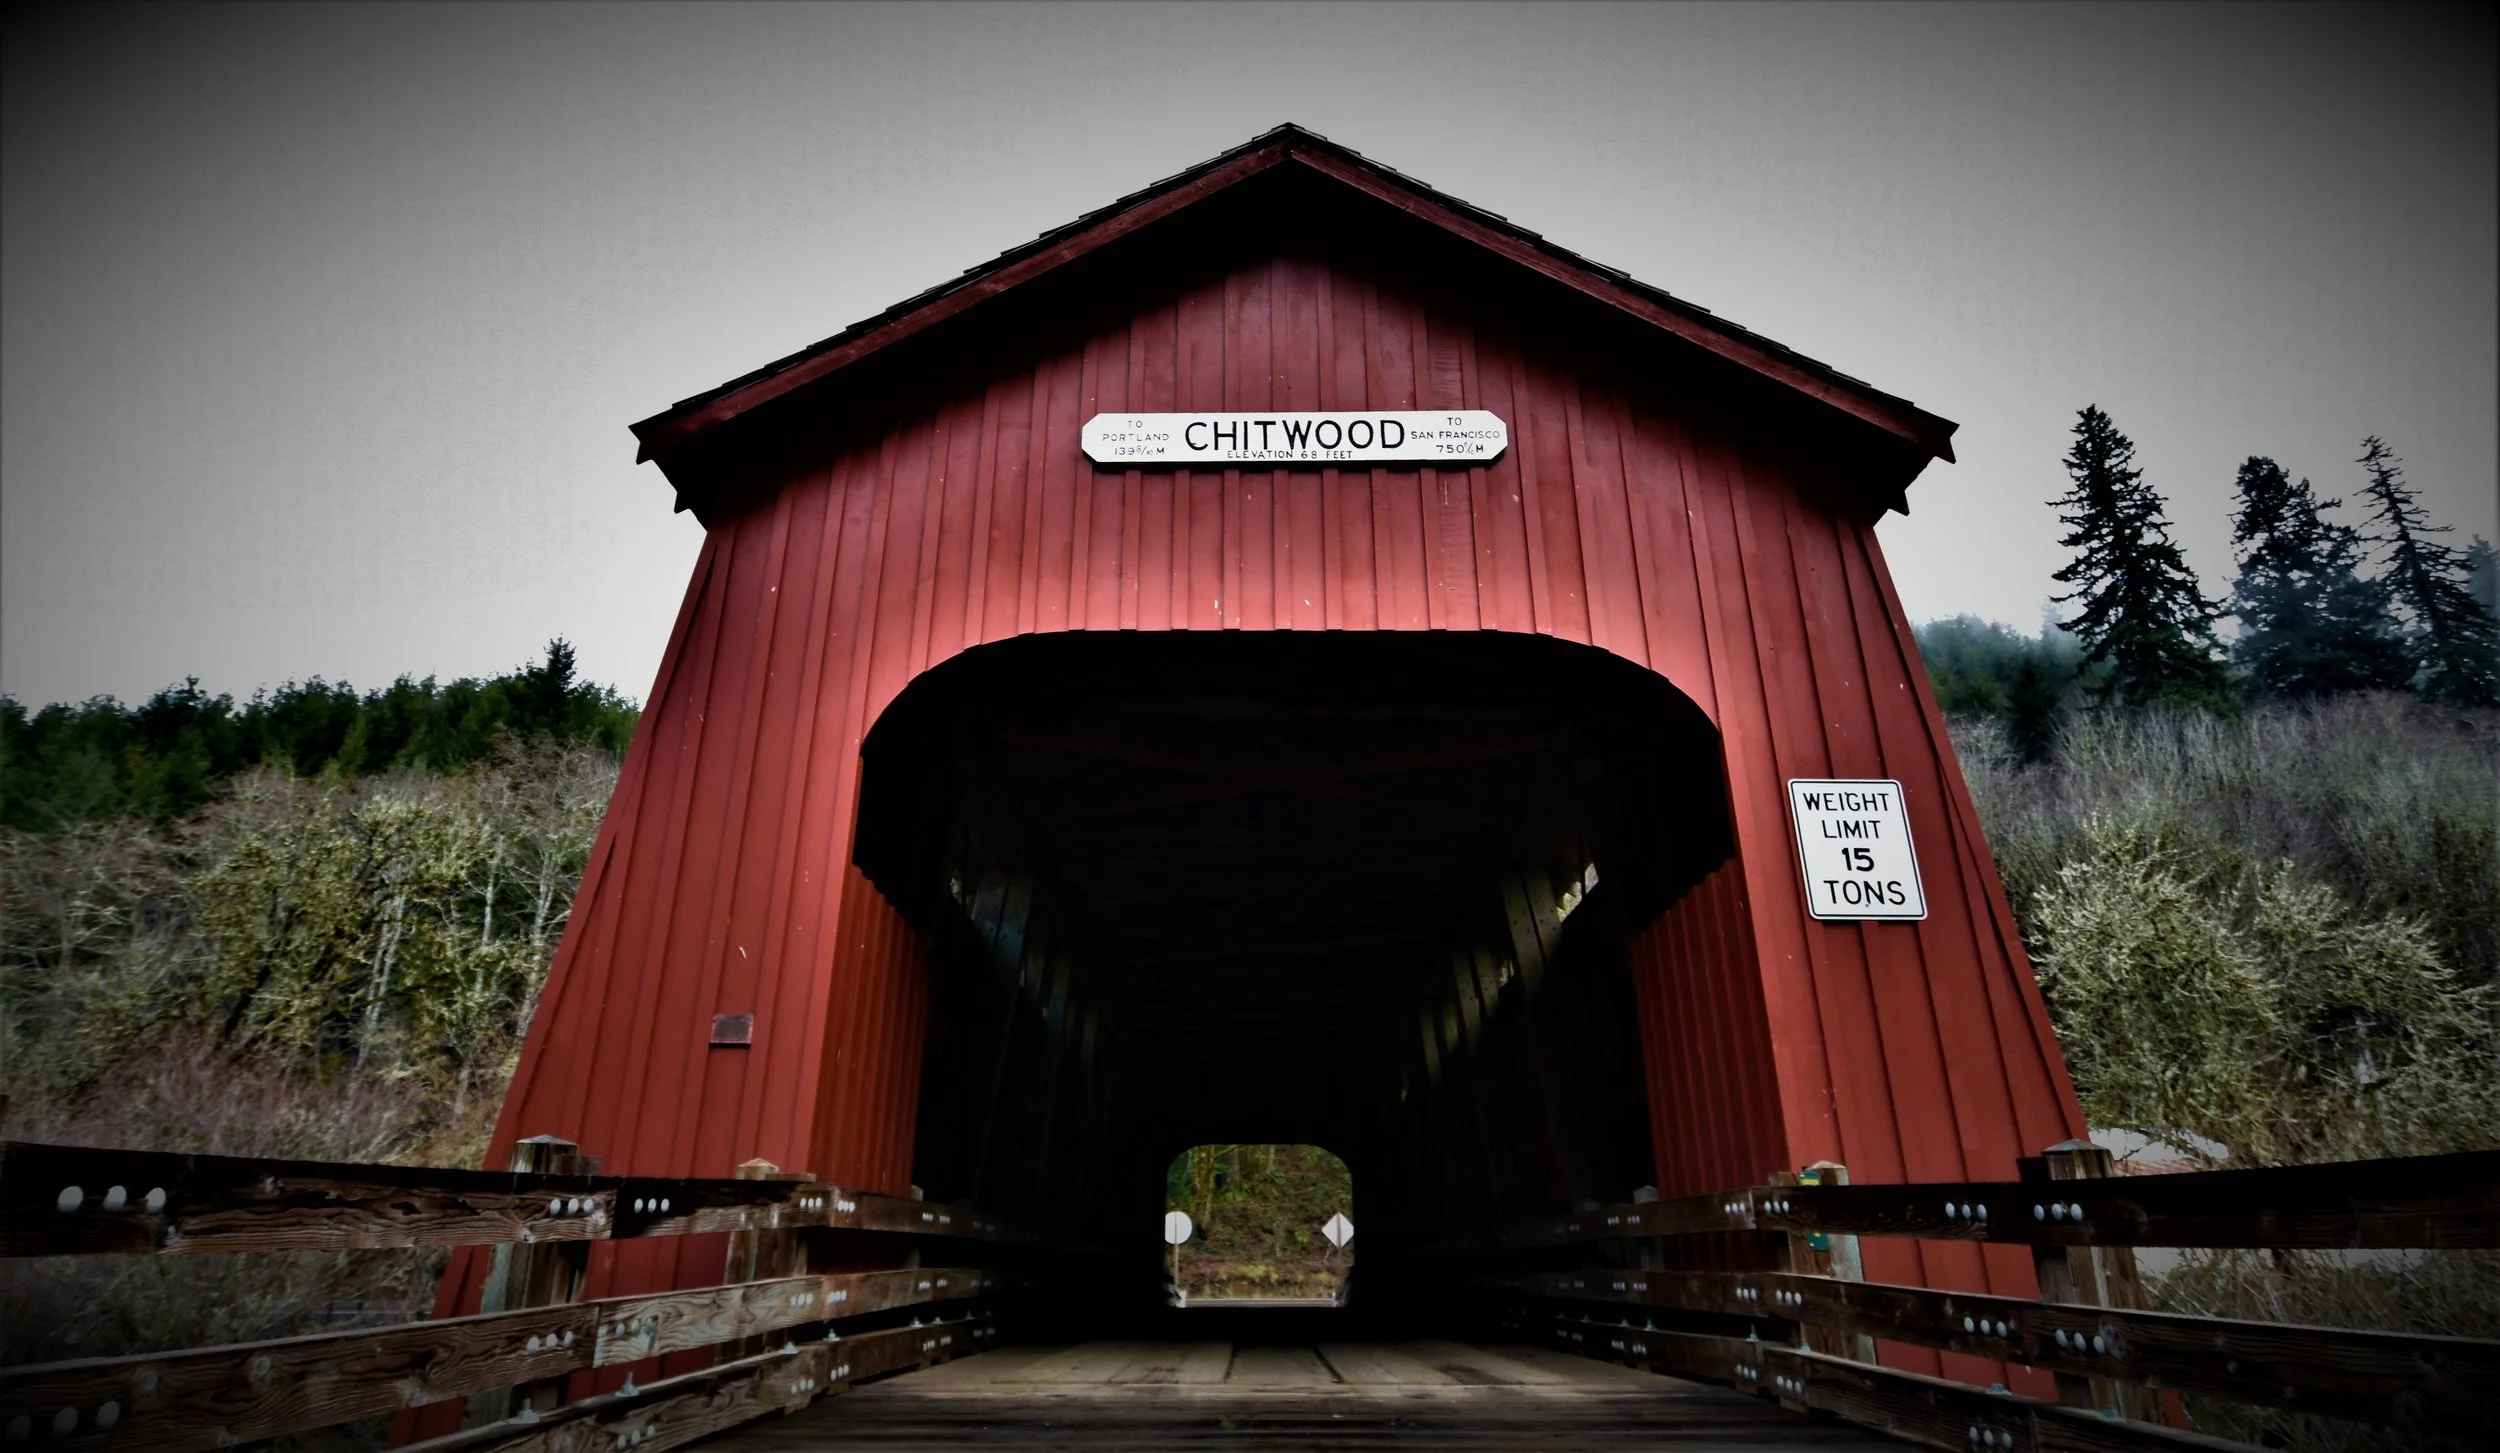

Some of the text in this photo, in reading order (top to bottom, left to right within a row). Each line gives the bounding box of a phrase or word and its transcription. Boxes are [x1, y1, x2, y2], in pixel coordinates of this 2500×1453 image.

[1128, 420, 1143, 428] TO
[1447, 417, 1462, 426] TO
[1102, 433, 1169, 442] PORTLAND
[1185, 419, 1405, 451] CHITWOOD
[1410, 430, 1500, 439] SAN FRANCISCO
[1156, 447, 1165, 455] M
[1475, 444, 1484, 453] M
[1227, 450, 1353, 459] ELEVATION 68 FEET
[1802, 791, 1889, 812] WEIGHT
[1821, 820, 1881, 839] LIMIT
[1841, 847, 1875, 872] 15
[1823, 880, 1906, 906] TONS
